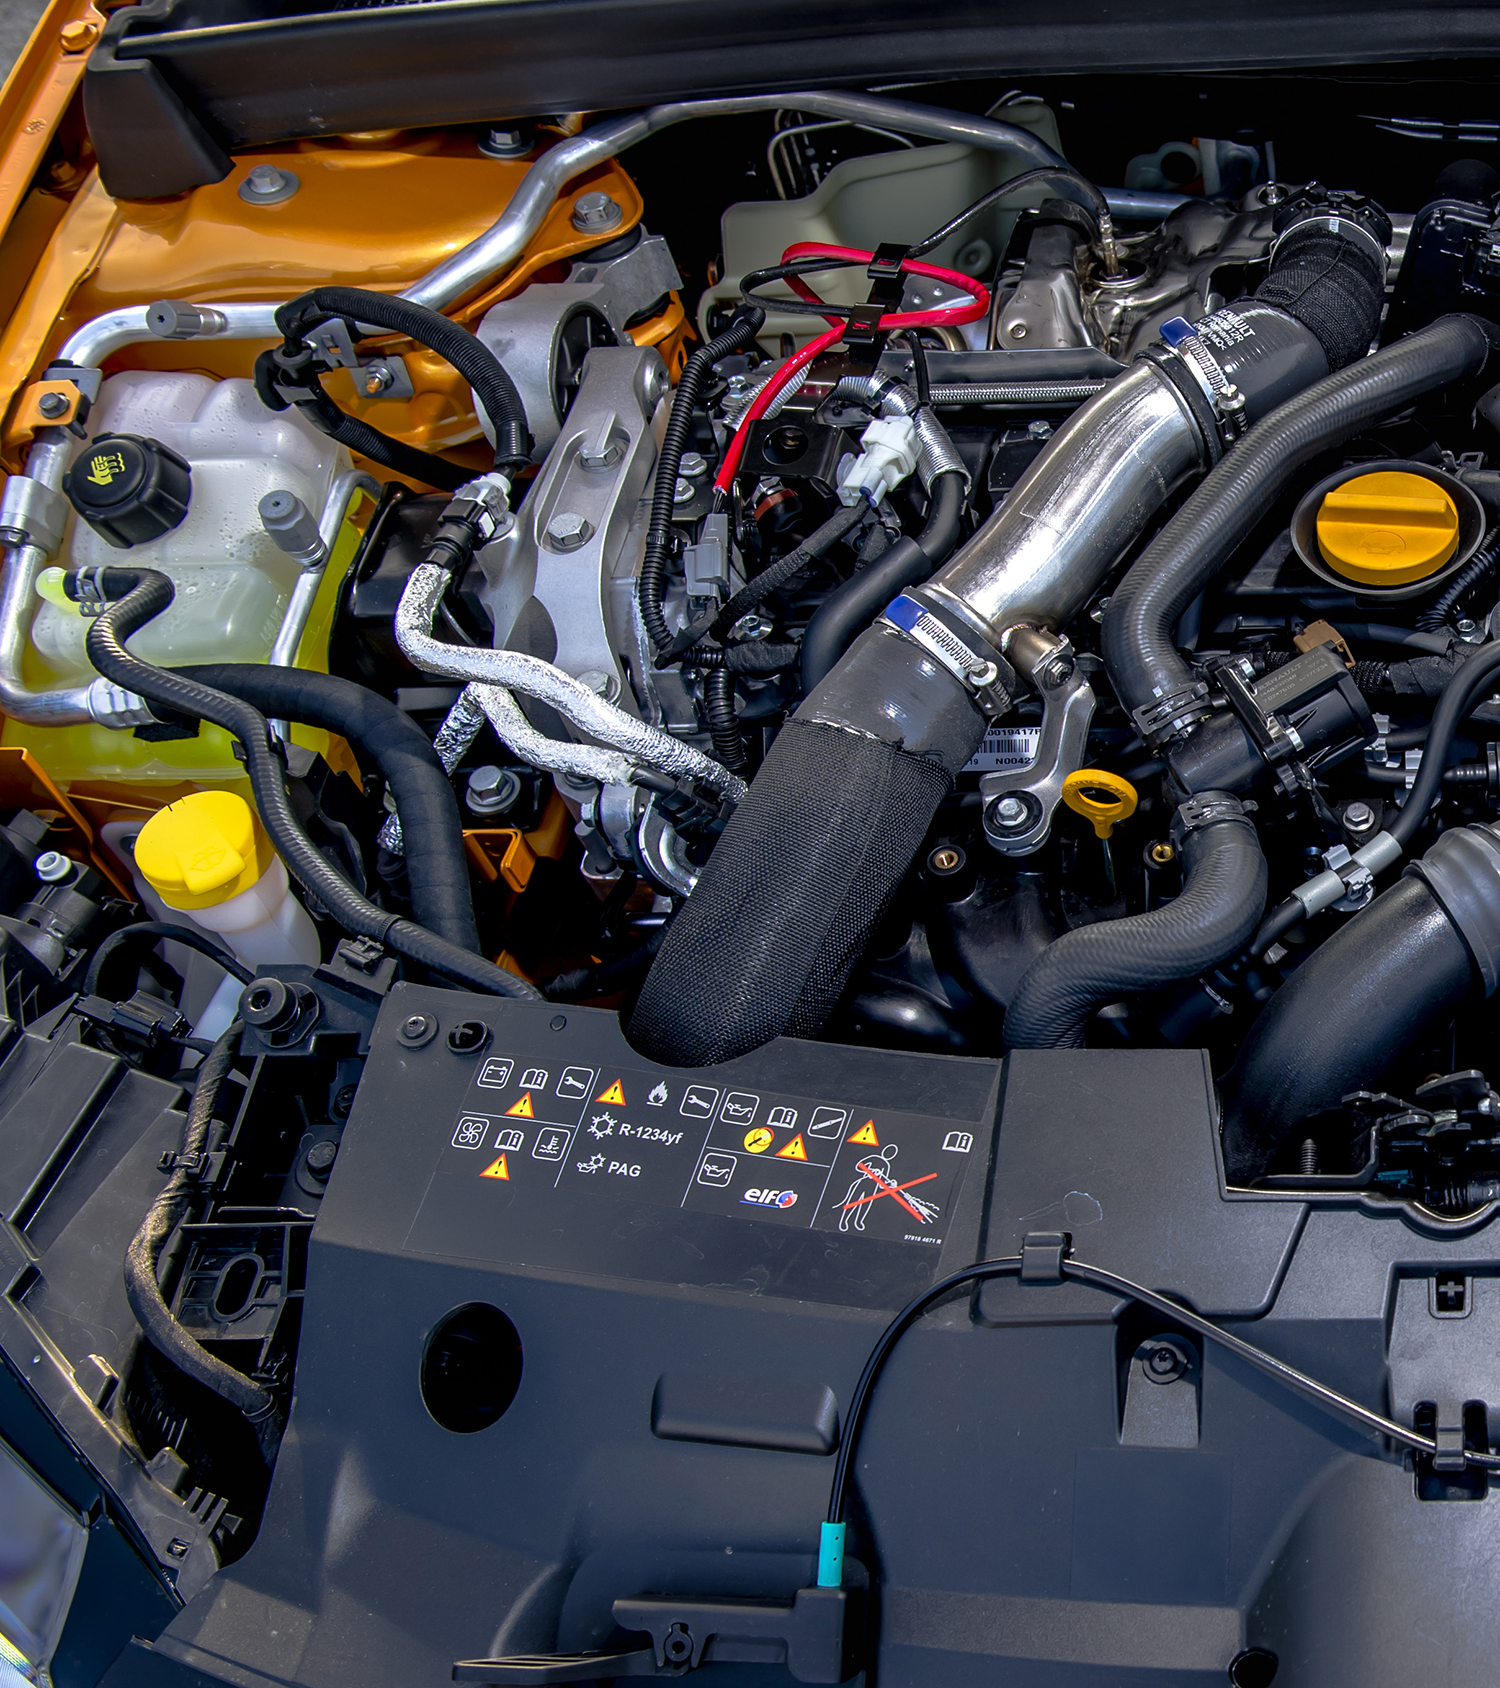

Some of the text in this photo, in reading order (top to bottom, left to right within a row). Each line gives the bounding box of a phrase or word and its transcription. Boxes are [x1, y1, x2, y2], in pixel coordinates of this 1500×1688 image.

[1215, 309, 1256, 337] RENAULT
[1258, 663, 1302, 690] RENAULT
[618, 1123, 684, 1146] R-1234yf
[607, 1161, 642, 1178] PAG
